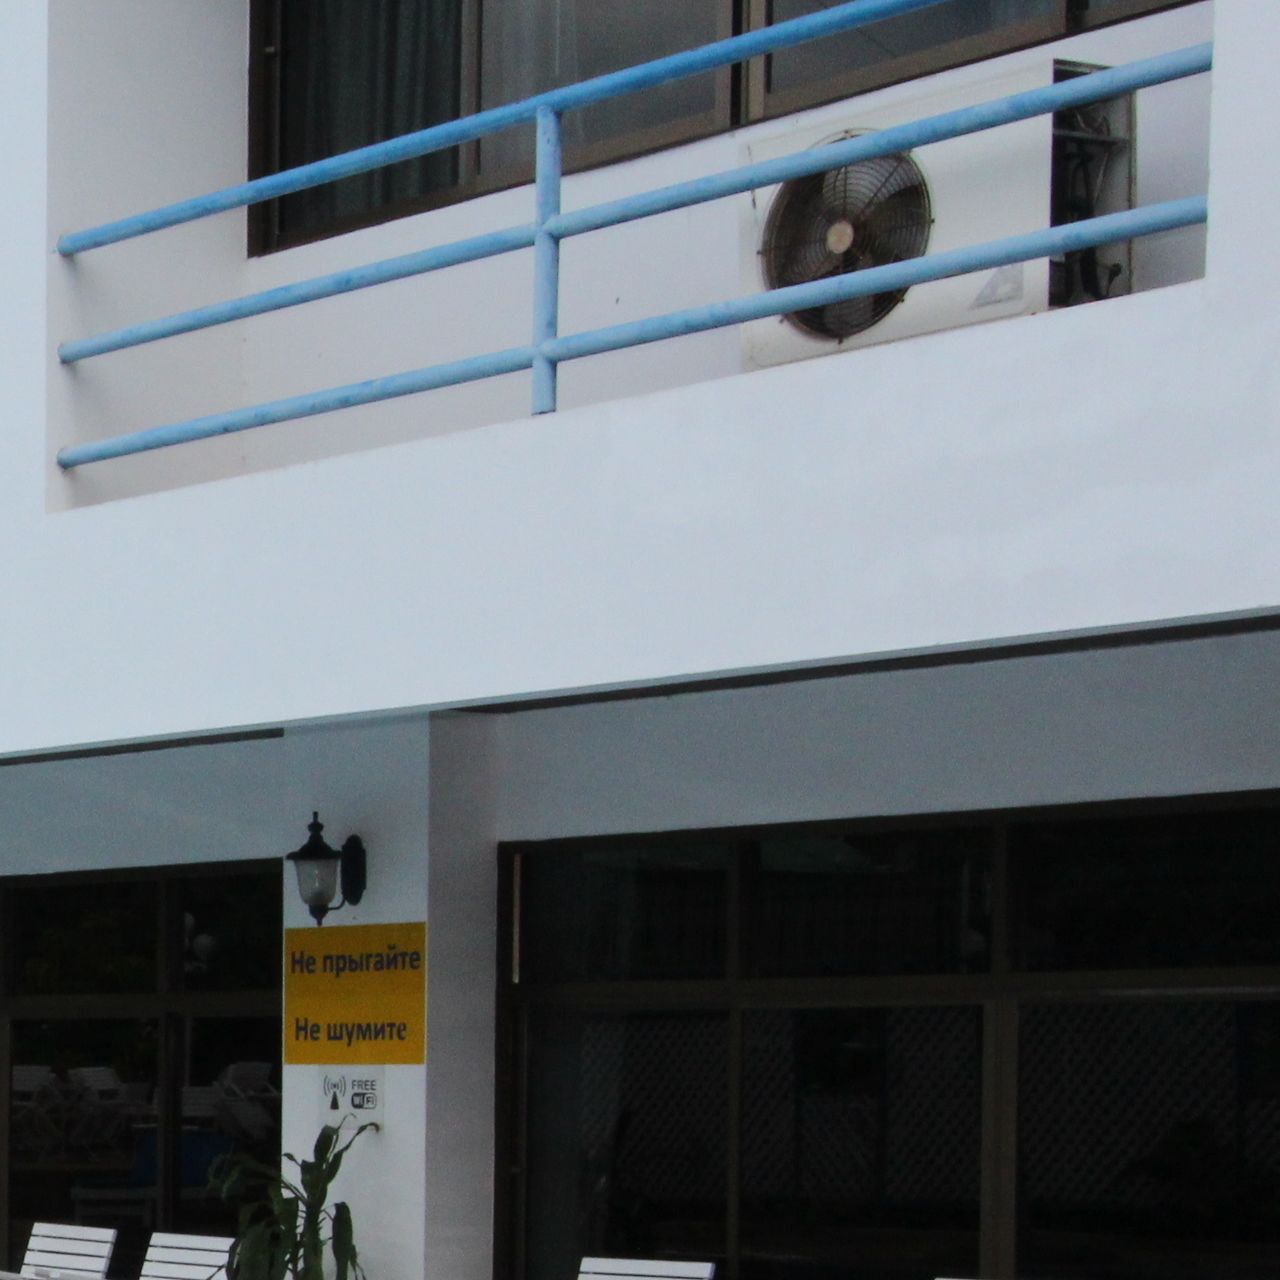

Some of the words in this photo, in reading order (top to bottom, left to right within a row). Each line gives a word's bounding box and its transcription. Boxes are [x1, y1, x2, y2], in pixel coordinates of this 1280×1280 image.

[291, 951, 316, 974] Не
[323, 944, 421, 977] прыгайте
[295, 1018, 320, 1041] Не
[327, 1022, 407, 1046] шумите
[351, 1080, 376, 1091] FREE
